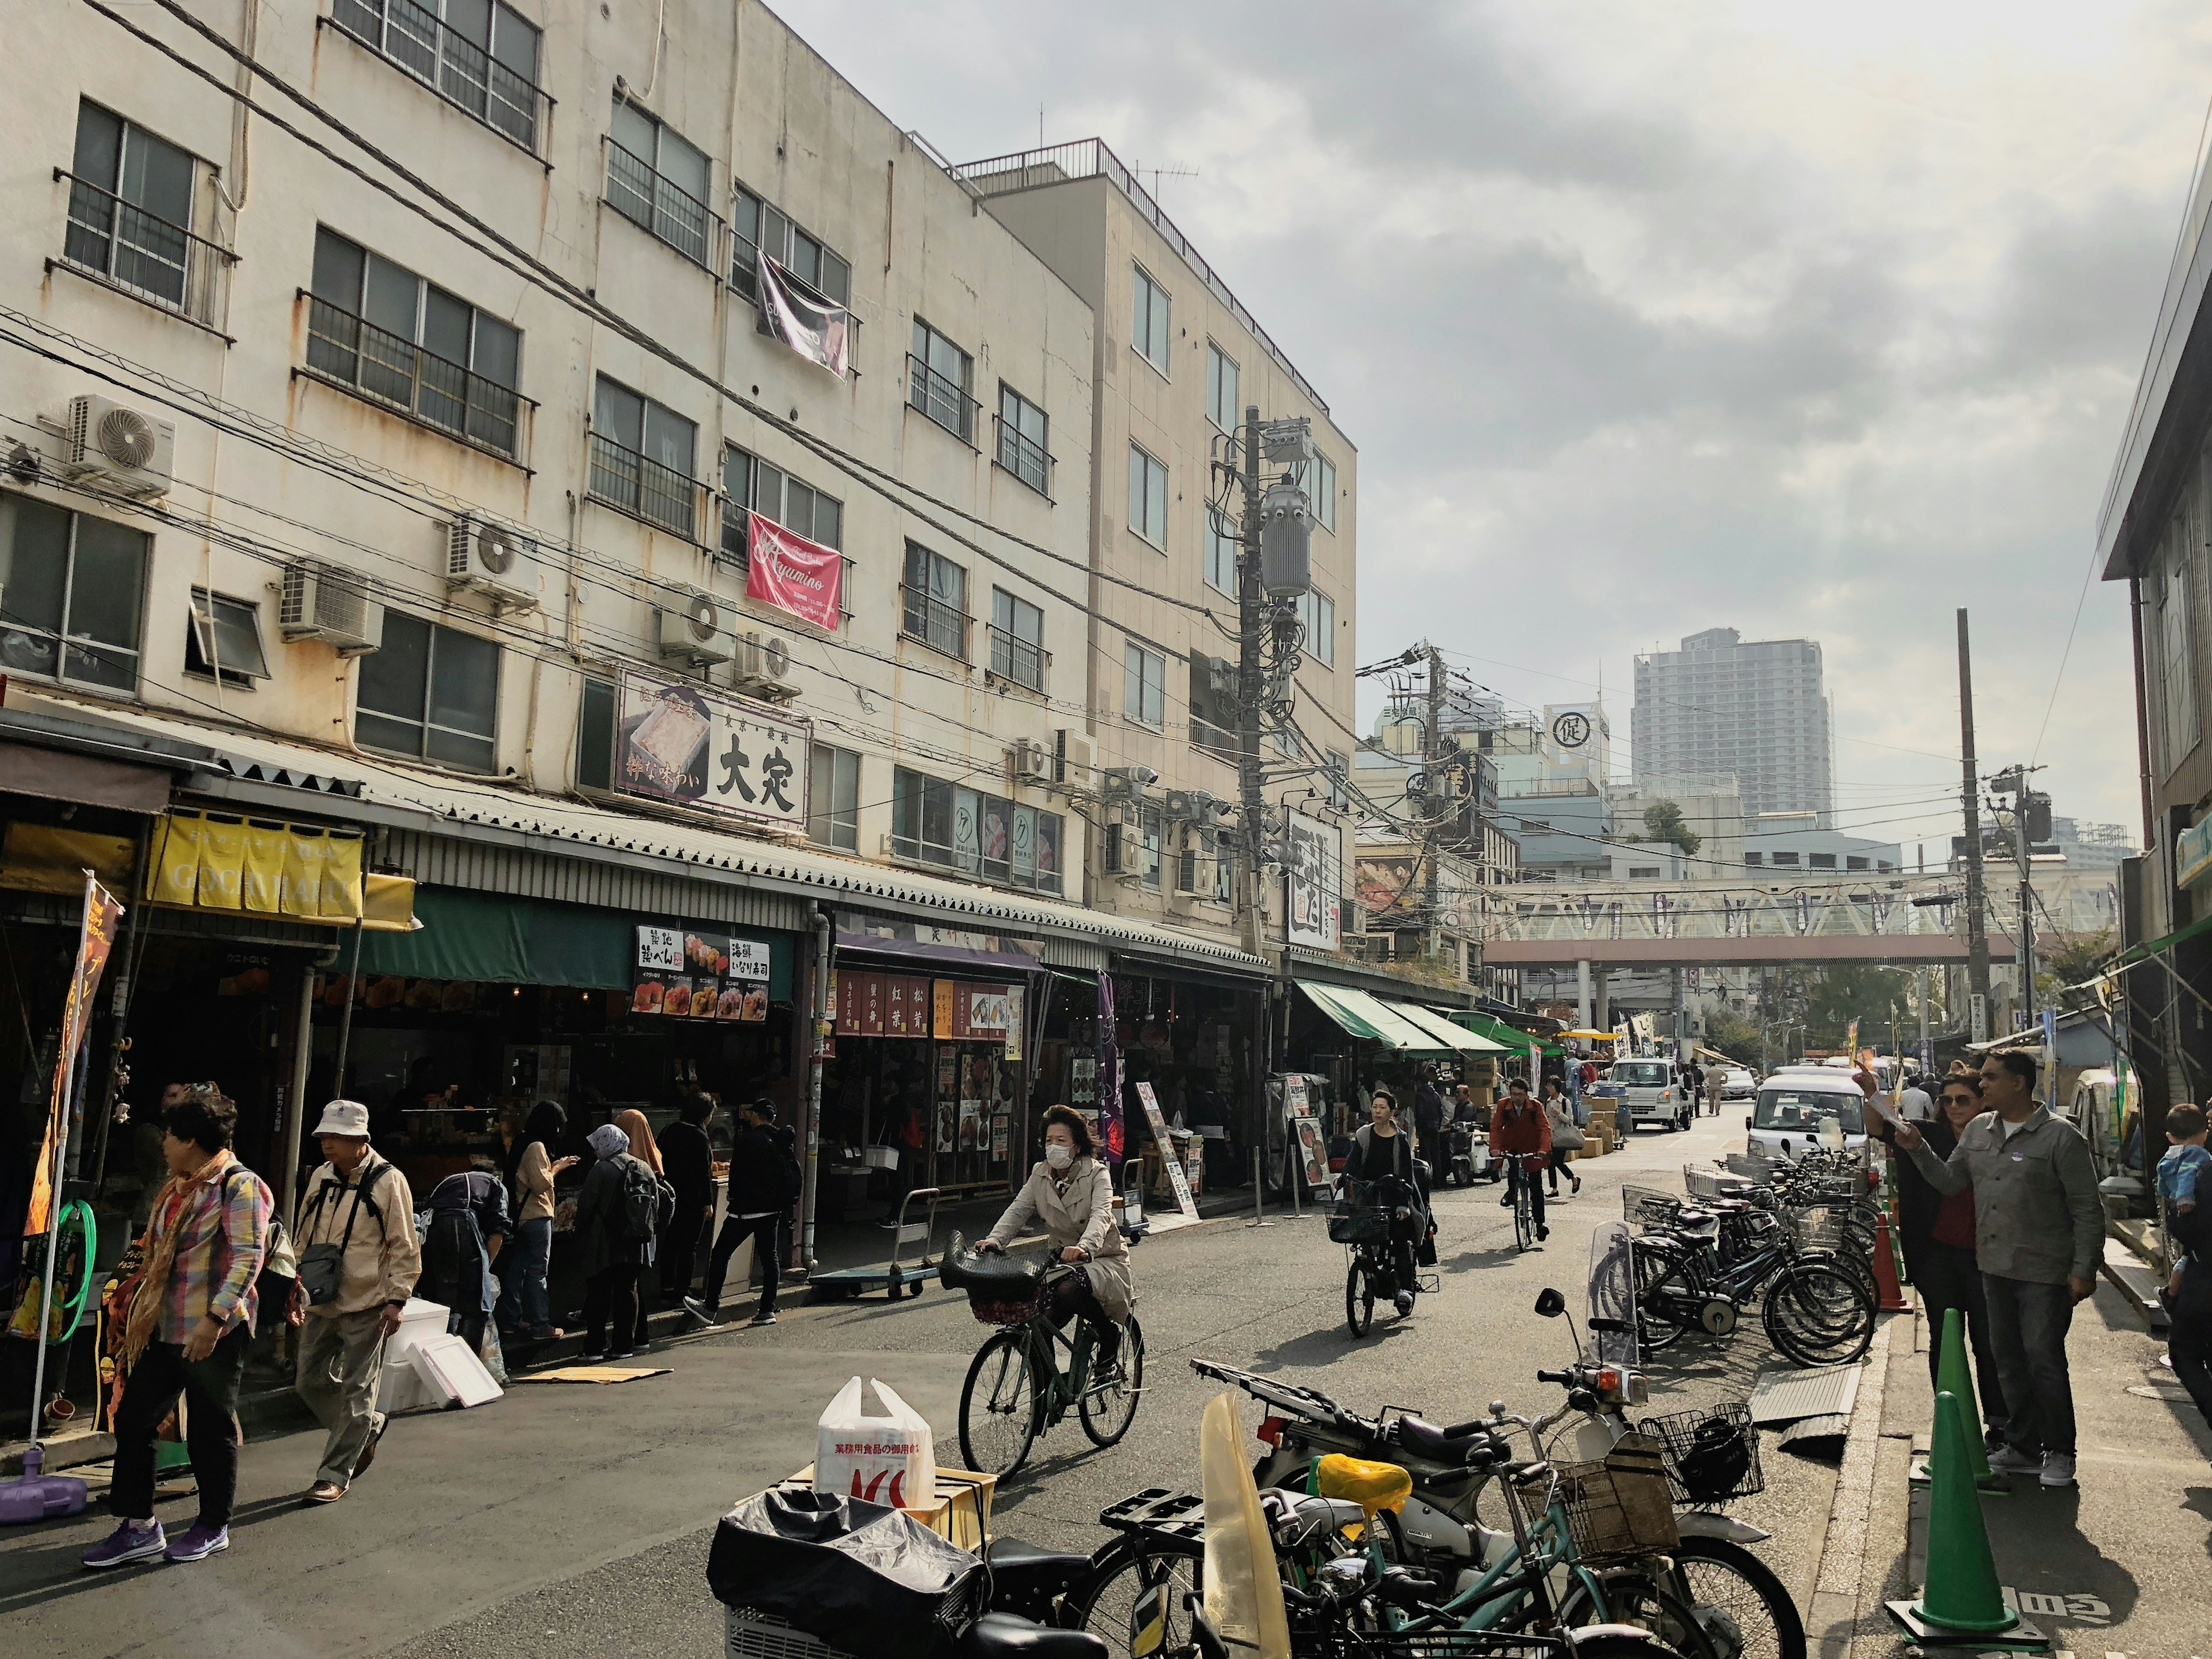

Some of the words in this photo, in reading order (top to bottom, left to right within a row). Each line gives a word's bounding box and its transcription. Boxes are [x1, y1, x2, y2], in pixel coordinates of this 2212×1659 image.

[754, 531, 824, 591] Ayumino
[626, 754, 700, 788] 粋な味わい
[716, 733, 795, 812] 大定
[732, 943, 752, 959] 海鮮
[732, 961, 767, 976] いなり寿司
[892, 985, 901, 1028] 紅葉
[914, 987, 923, 1029] 松茸
